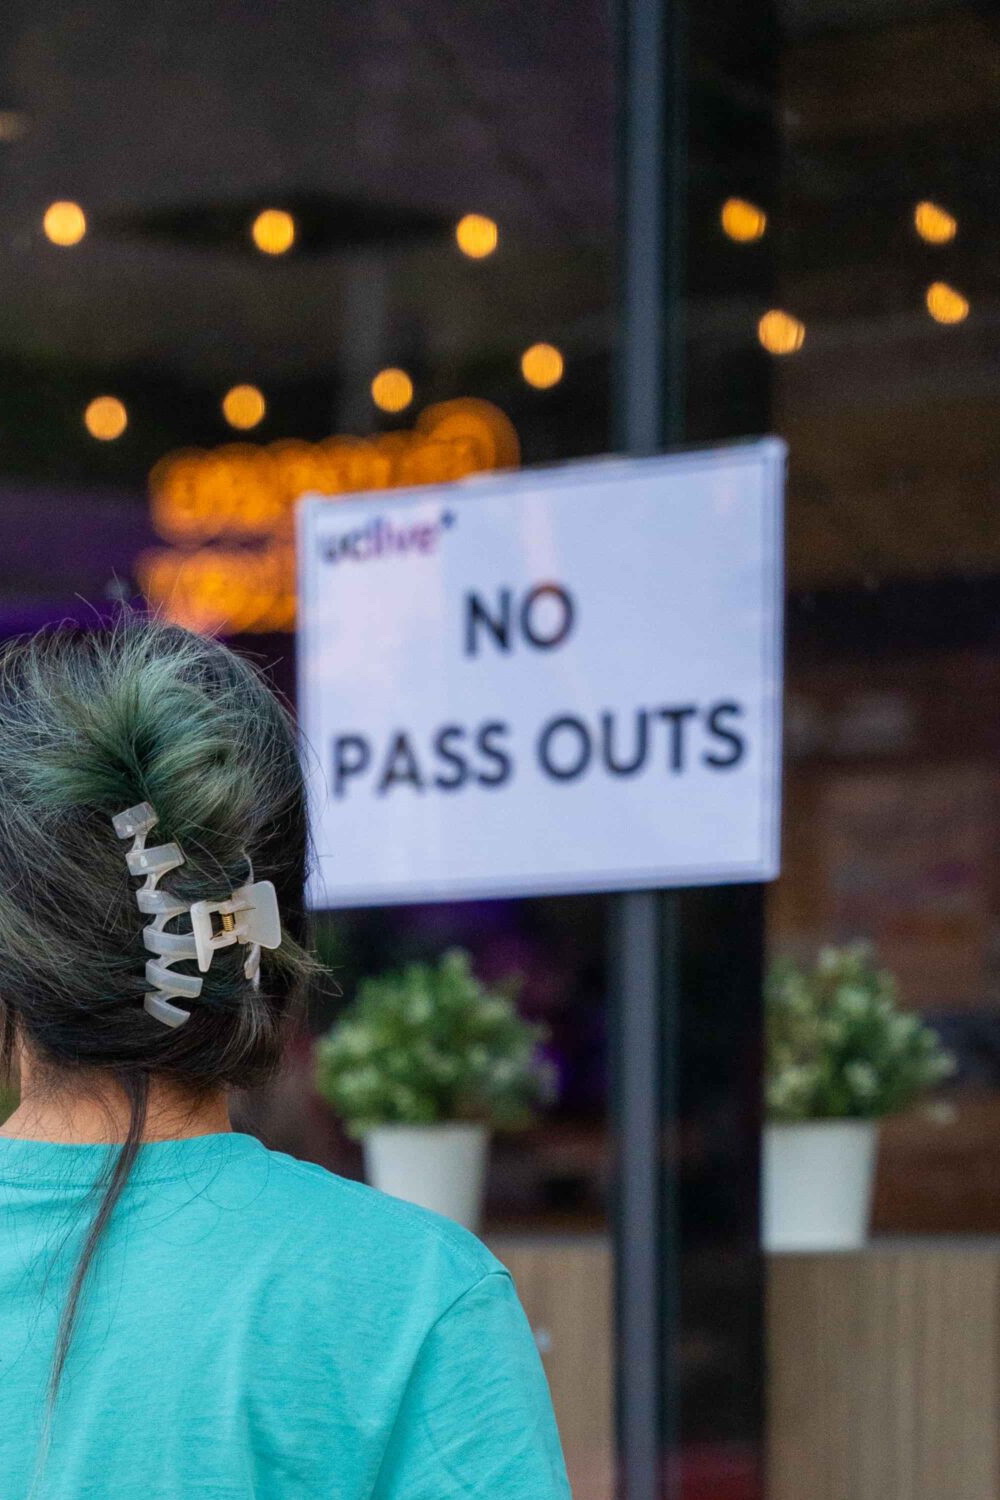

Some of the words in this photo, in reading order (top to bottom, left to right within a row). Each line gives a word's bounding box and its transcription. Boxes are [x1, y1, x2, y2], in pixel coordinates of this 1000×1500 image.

[463, 581, 576, 658] NO
[331, 719, 512, 799] PASS
[536, 700, 747, 785] OUTS
